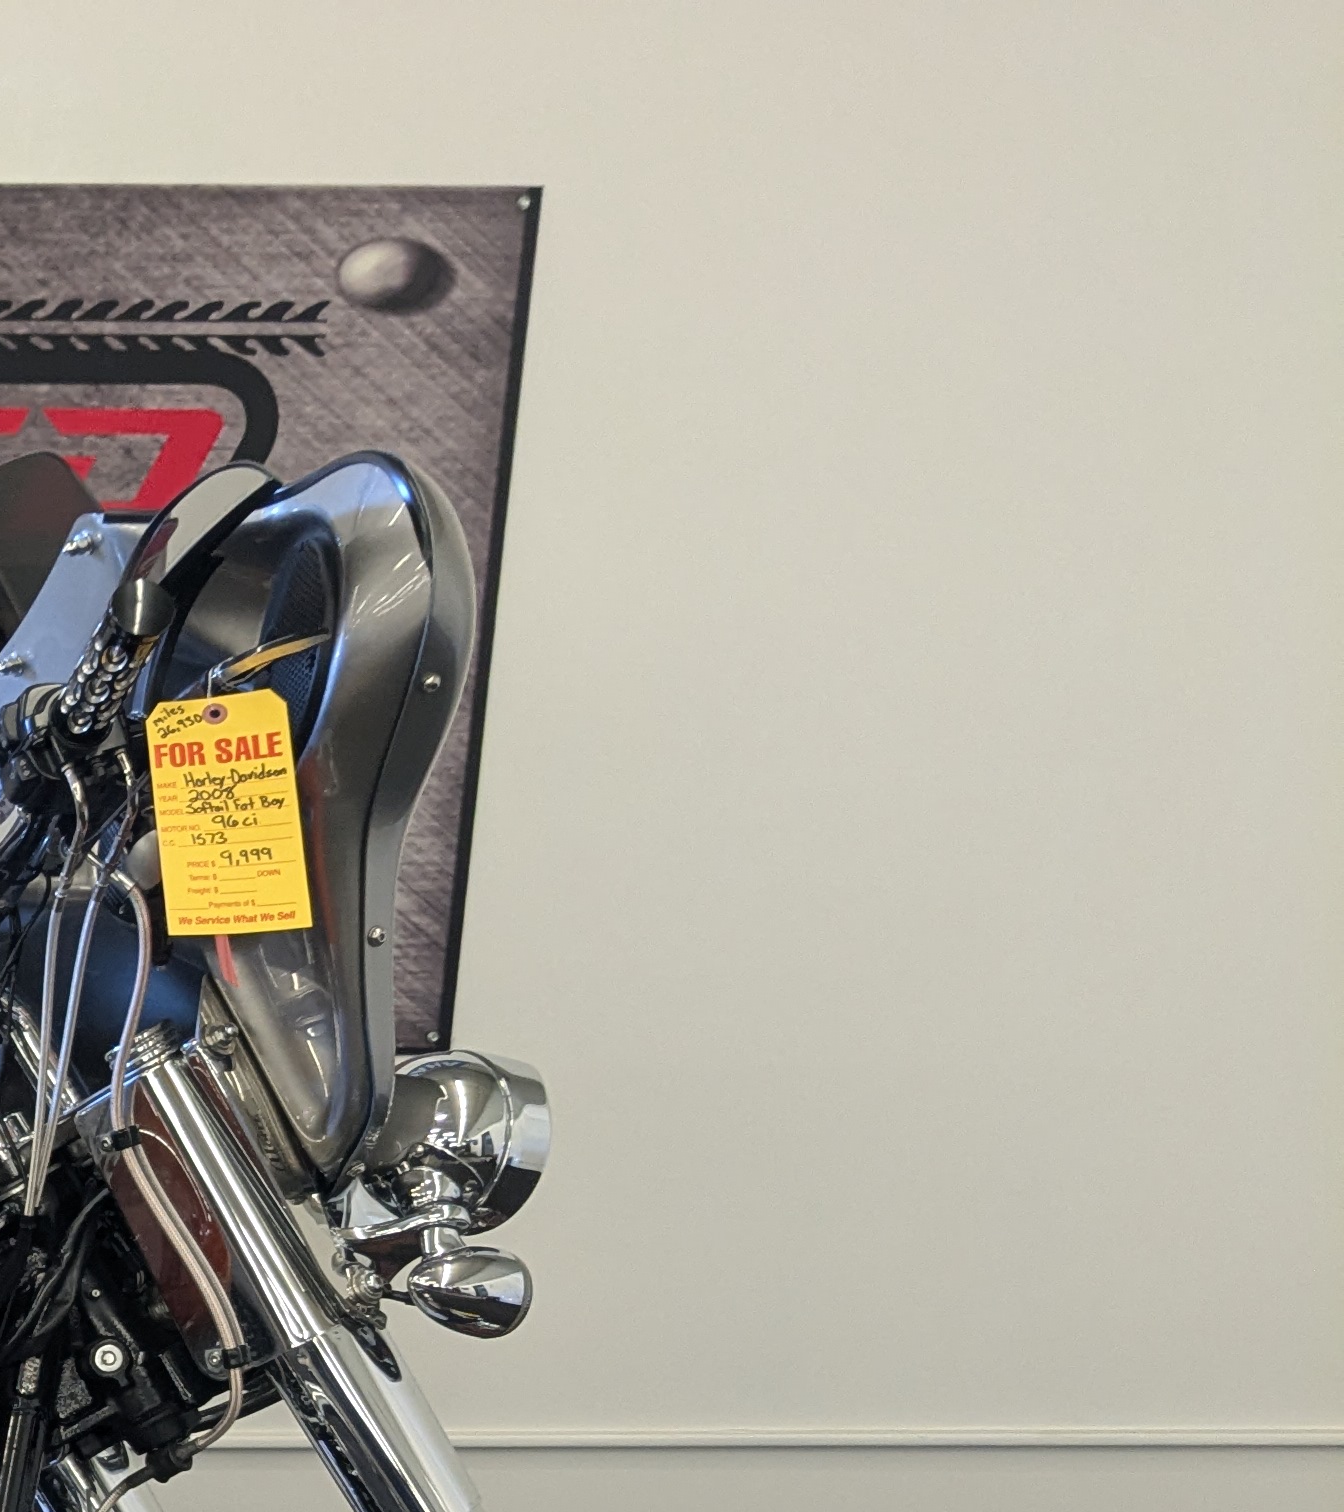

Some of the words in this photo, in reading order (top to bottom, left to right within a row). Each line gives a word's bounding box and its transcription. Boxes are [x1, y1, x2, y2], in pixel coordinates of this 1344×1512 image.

[154, 741, 206, 768] FOR
[214, 731, 284, 764] SALE
[183, 763, 287, 788] Harley-Davidson
[188, 786, 235, 802] 2008
[259, 795, 285, 809] Boy
[191, 832, 228, 846] 1573
[219, 847, 273, 866] 9,999
[256, 869, 281, 877] DOWN
[178, 917, 193, 925] We
[195, 916, 231, 925] Service
[233, 914, 258, 923] What
[260, 913, 275, 921] We
[277, 910, 296, 920] Sell
